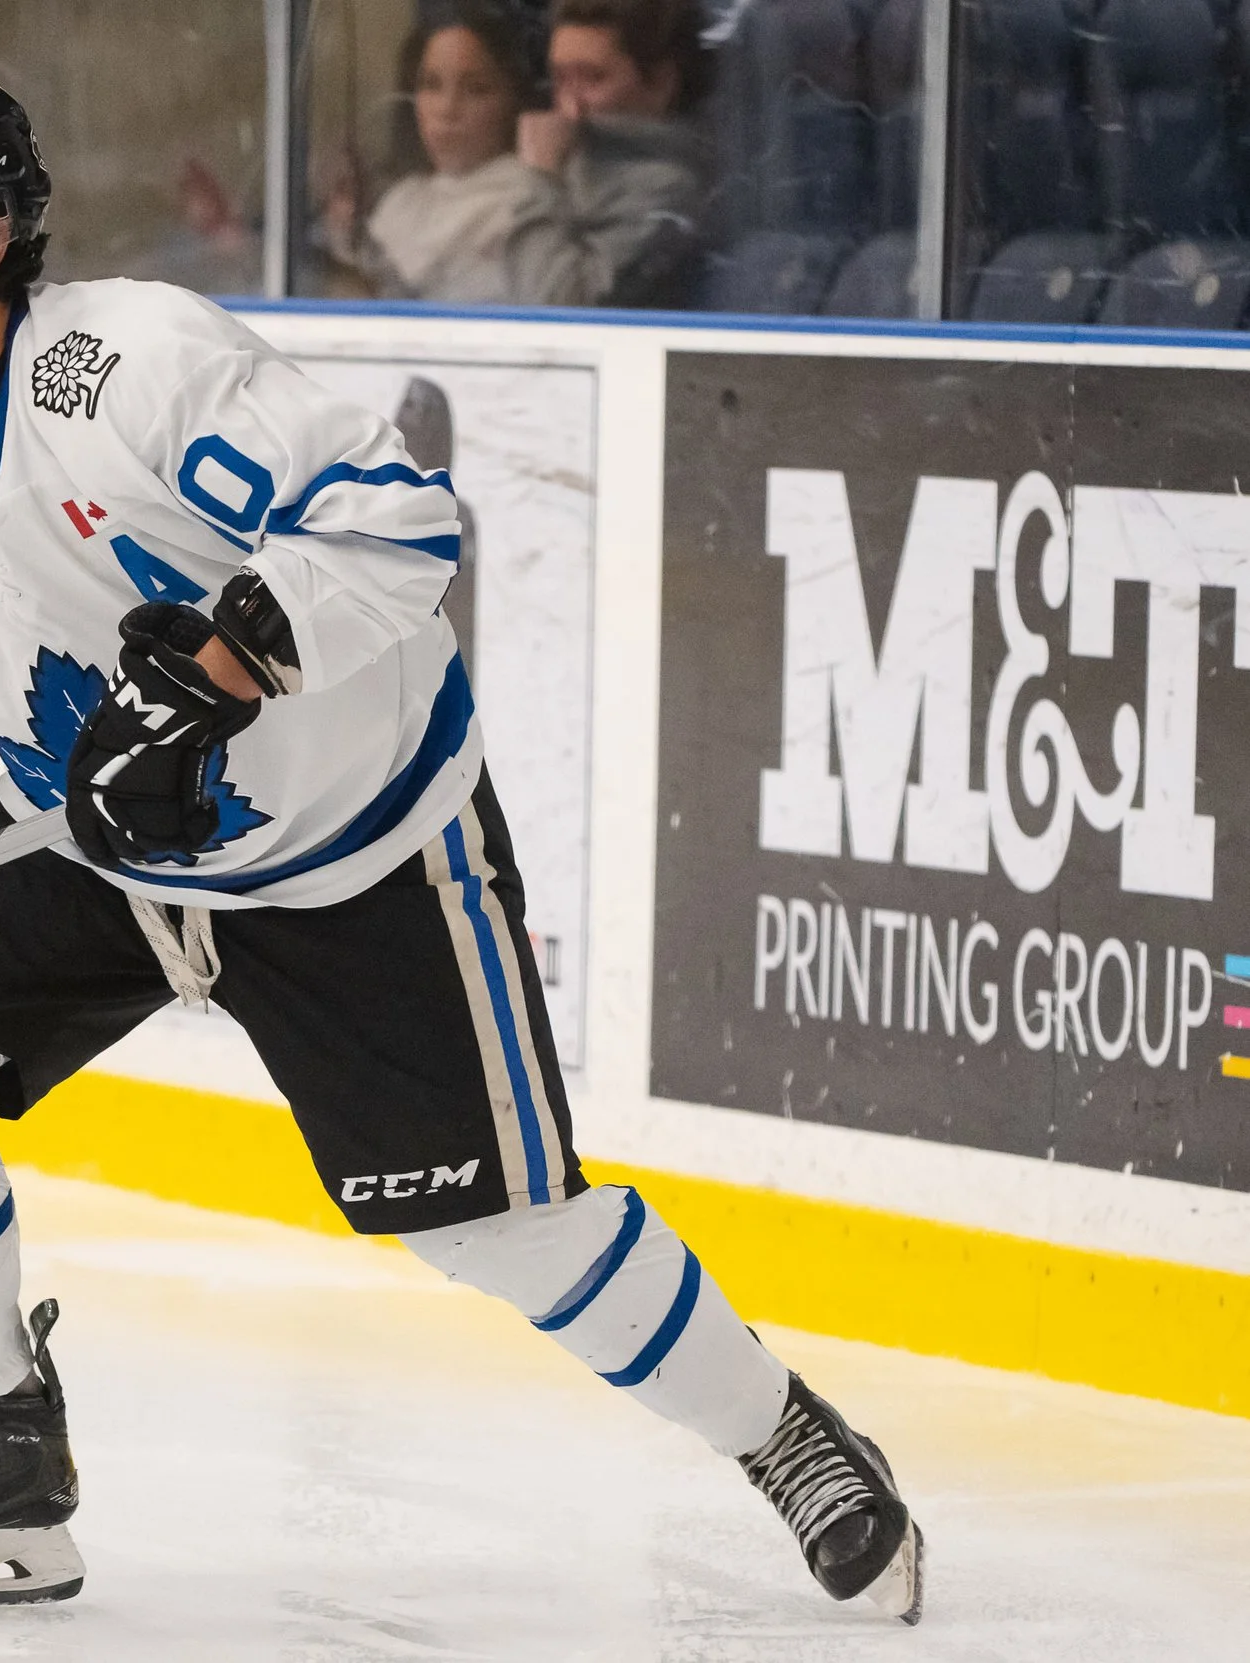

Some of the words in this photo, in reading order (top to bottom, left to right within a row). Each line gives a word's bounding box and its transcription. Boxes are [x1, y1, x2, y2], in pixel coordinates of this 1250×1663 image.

[109, 534, 209, 604] A
[759, 467, 1250, 900] M&T
[754, 896, 999, 1042] PRINTING
[1013, 928, 1213, 1070] GROUP
[341, 1159, 480, 1202] CCM
